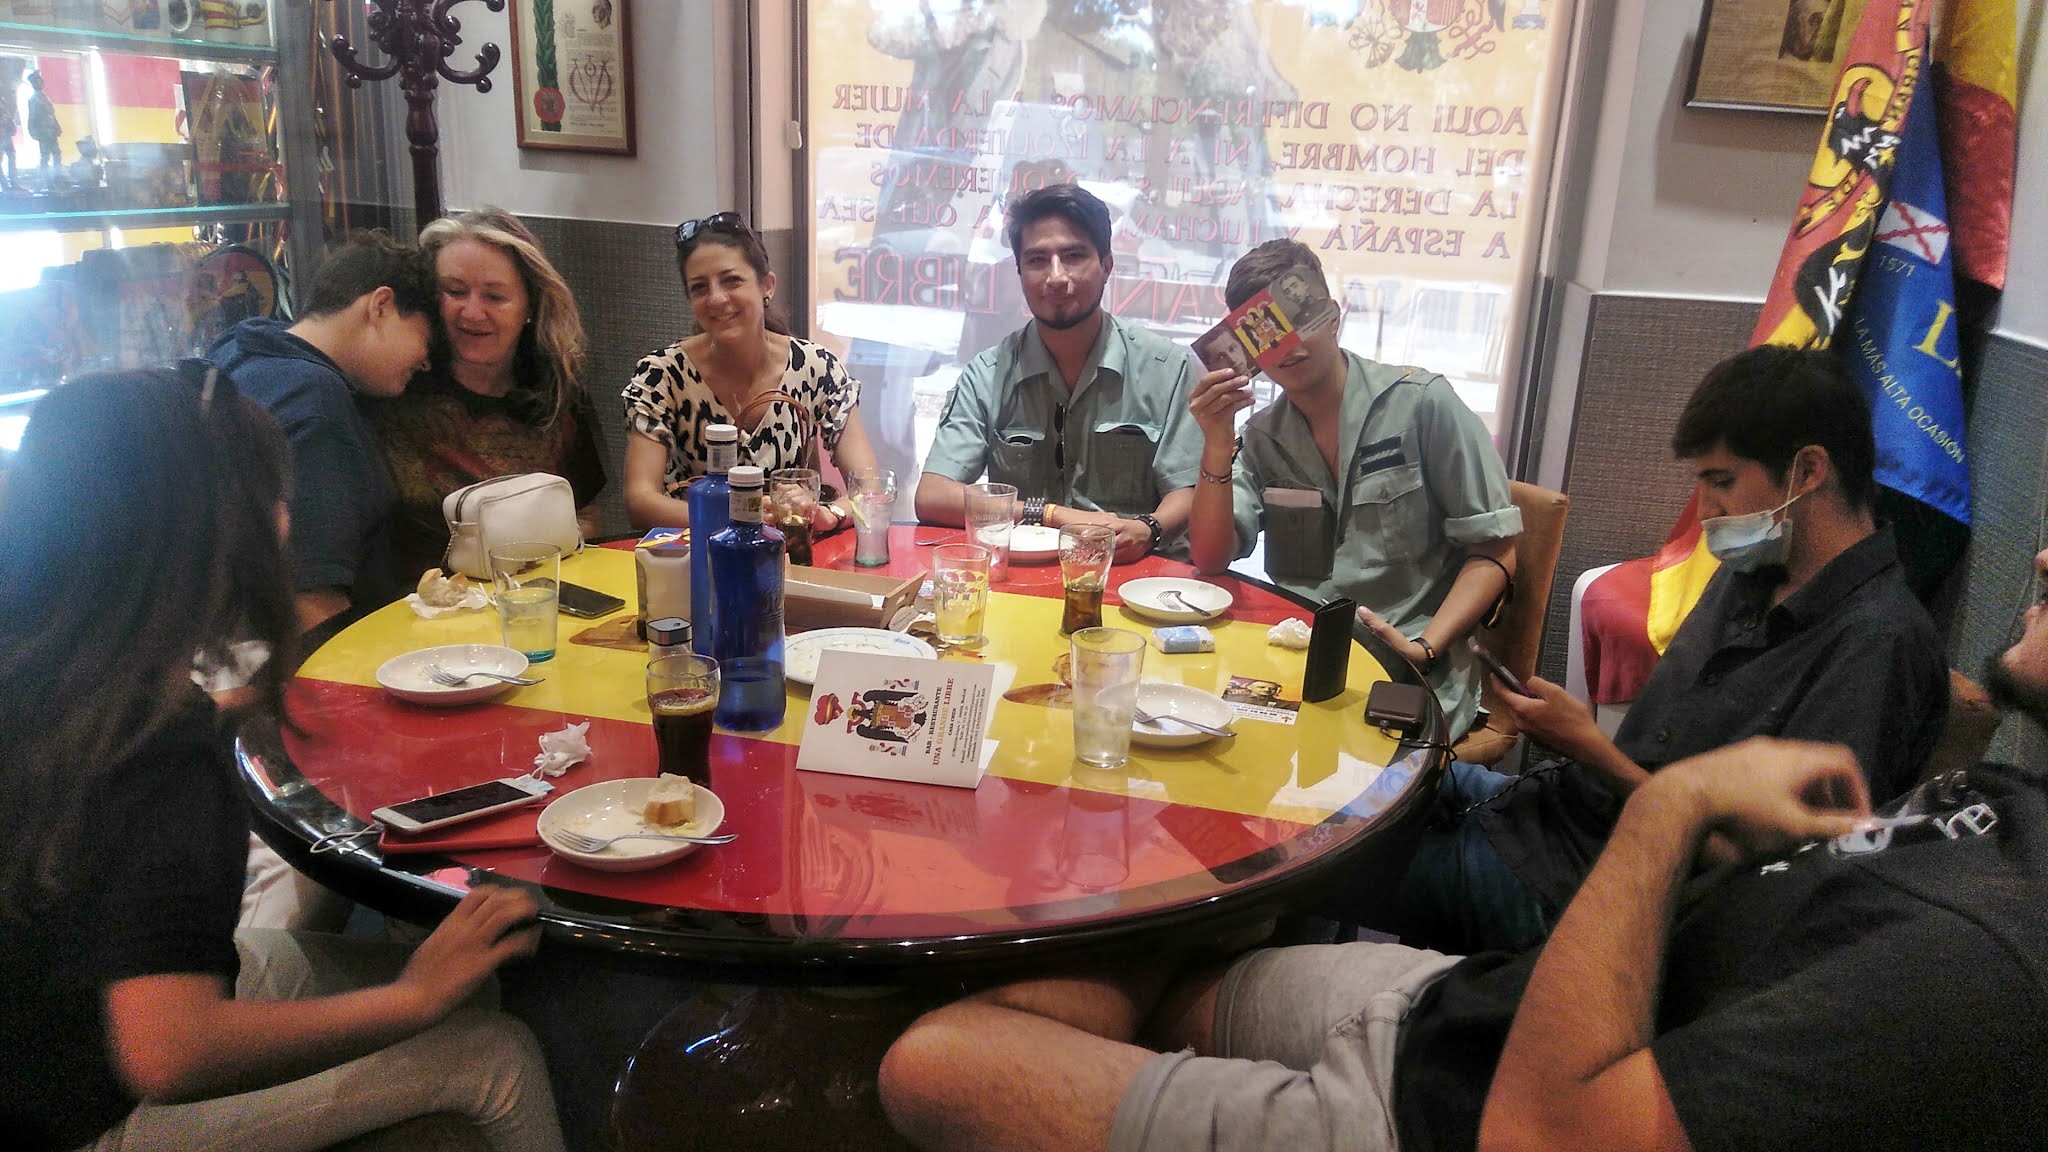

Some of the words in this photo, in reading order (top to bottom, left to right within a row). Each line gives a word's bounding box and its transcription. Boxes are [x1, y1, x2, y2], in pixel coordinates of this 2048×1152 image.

[1853, 318, 1870, 340] LA
[1878, 374, 1912, 410] ALTA
[944, 678, 954, 705] LIBRE
[929, 687, 942, 735] RESTAURANTE
[937, 706, 949, 744] GRANDE
[933, 747, 942, 766] UNA
